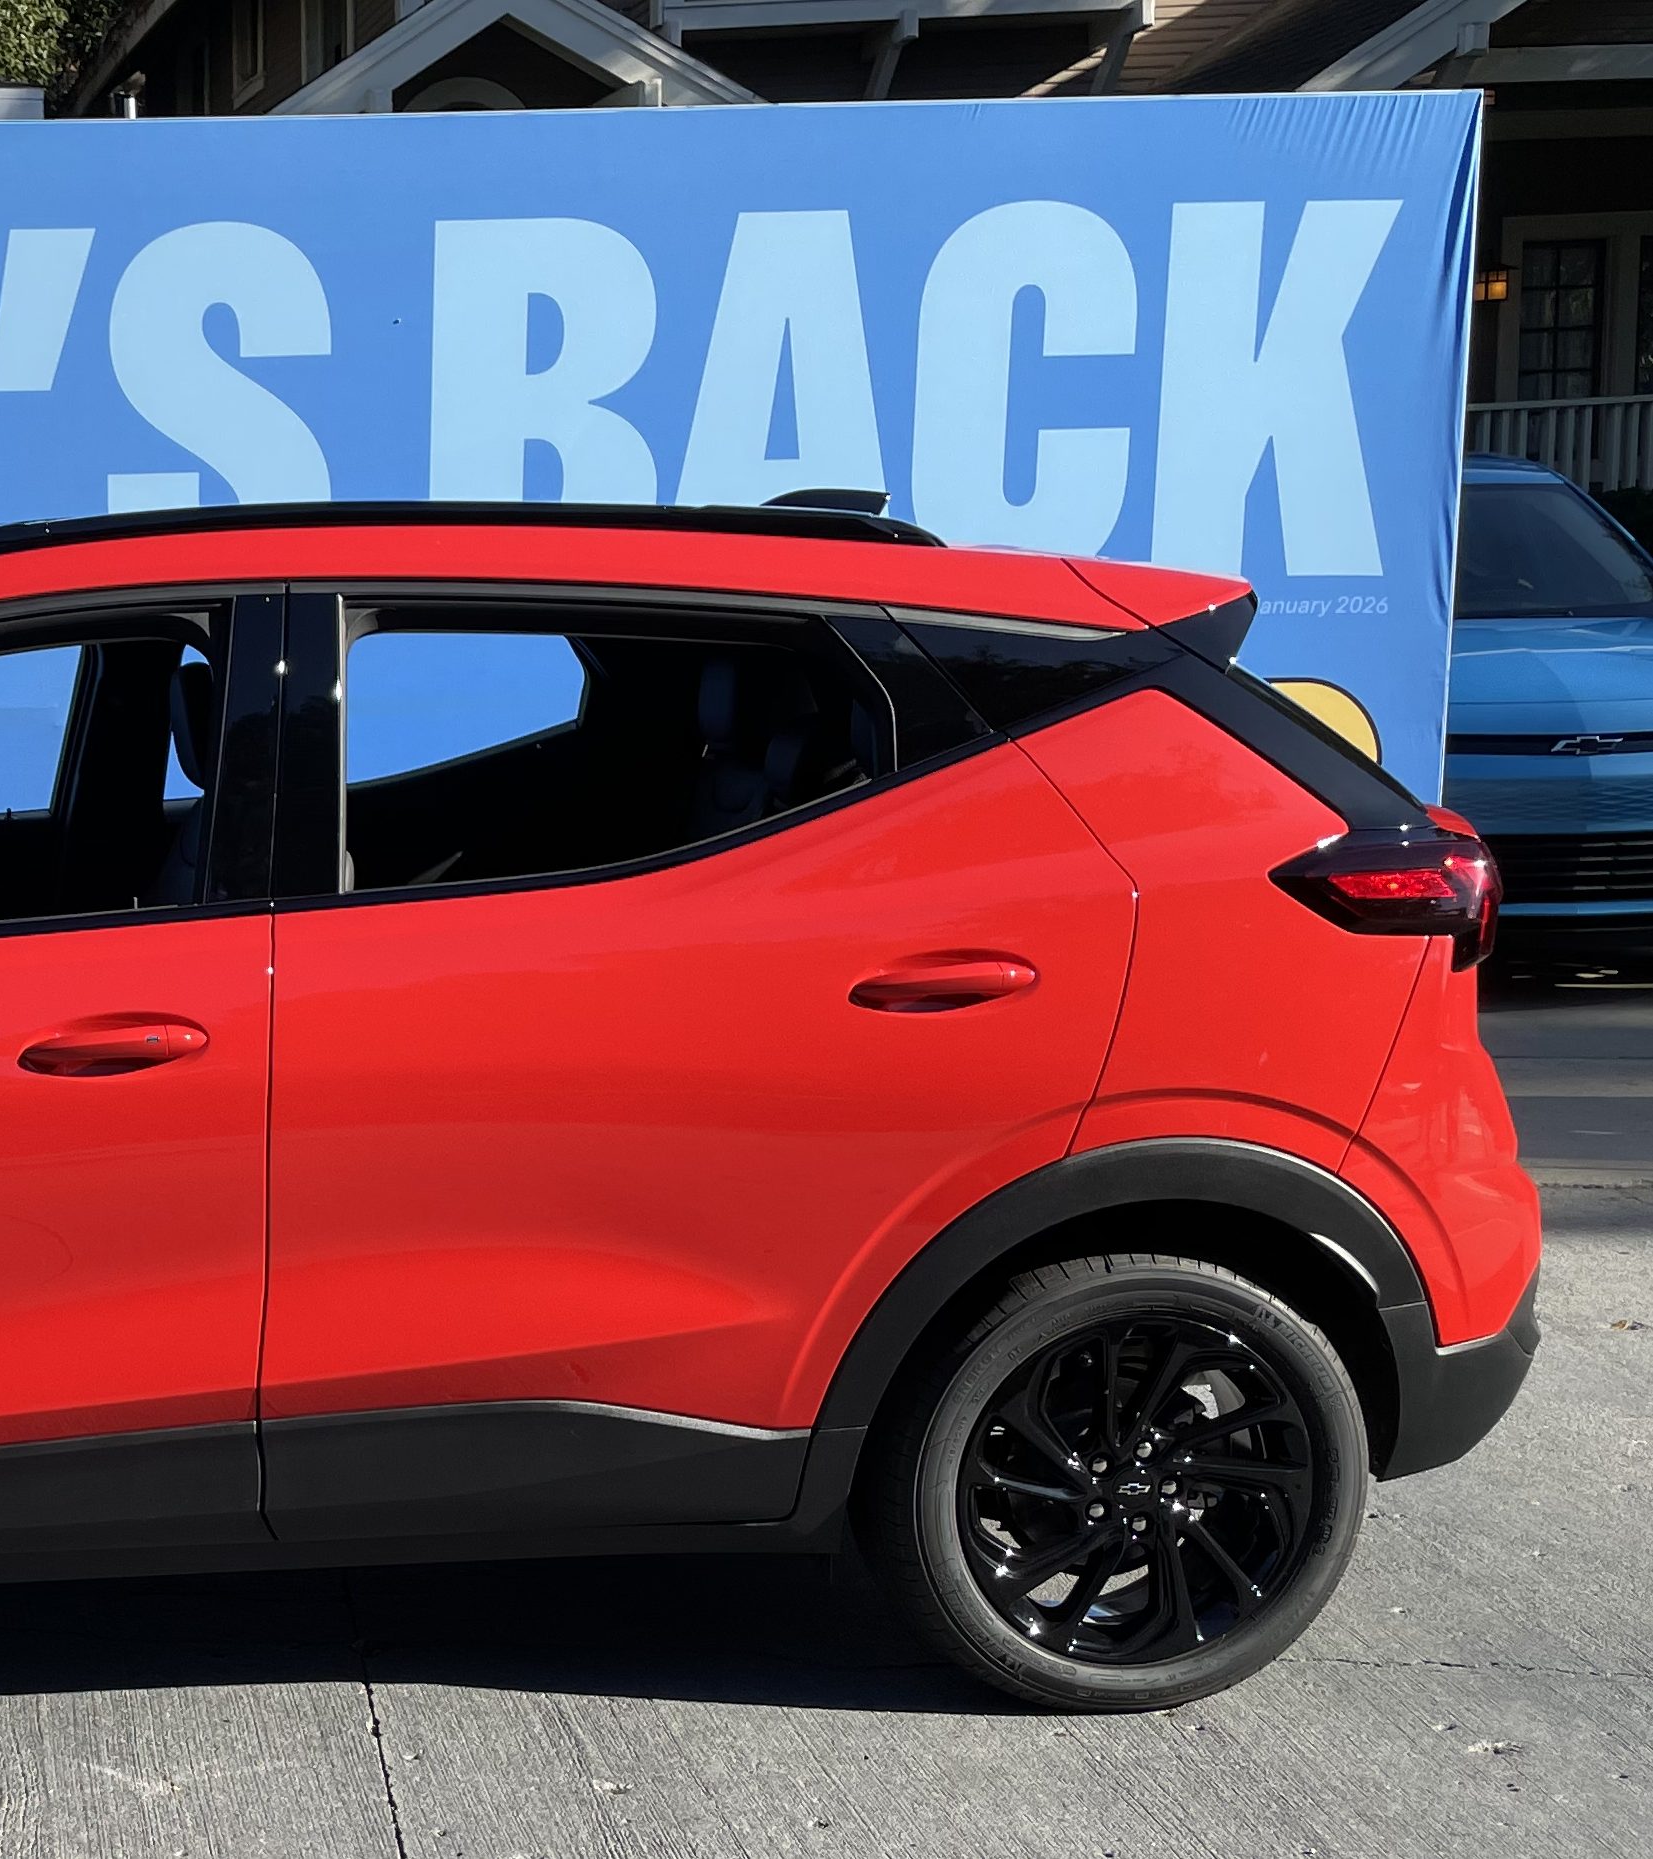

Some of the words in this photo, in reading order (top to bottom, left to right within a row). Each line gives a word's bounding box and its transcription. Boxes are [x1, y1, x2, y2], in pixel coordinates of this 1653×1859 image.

[429, 200, 1403, 576] BACK
[1259, 599, 1332, 618] anuary
[1335, 596, 1389, 614] 2026
